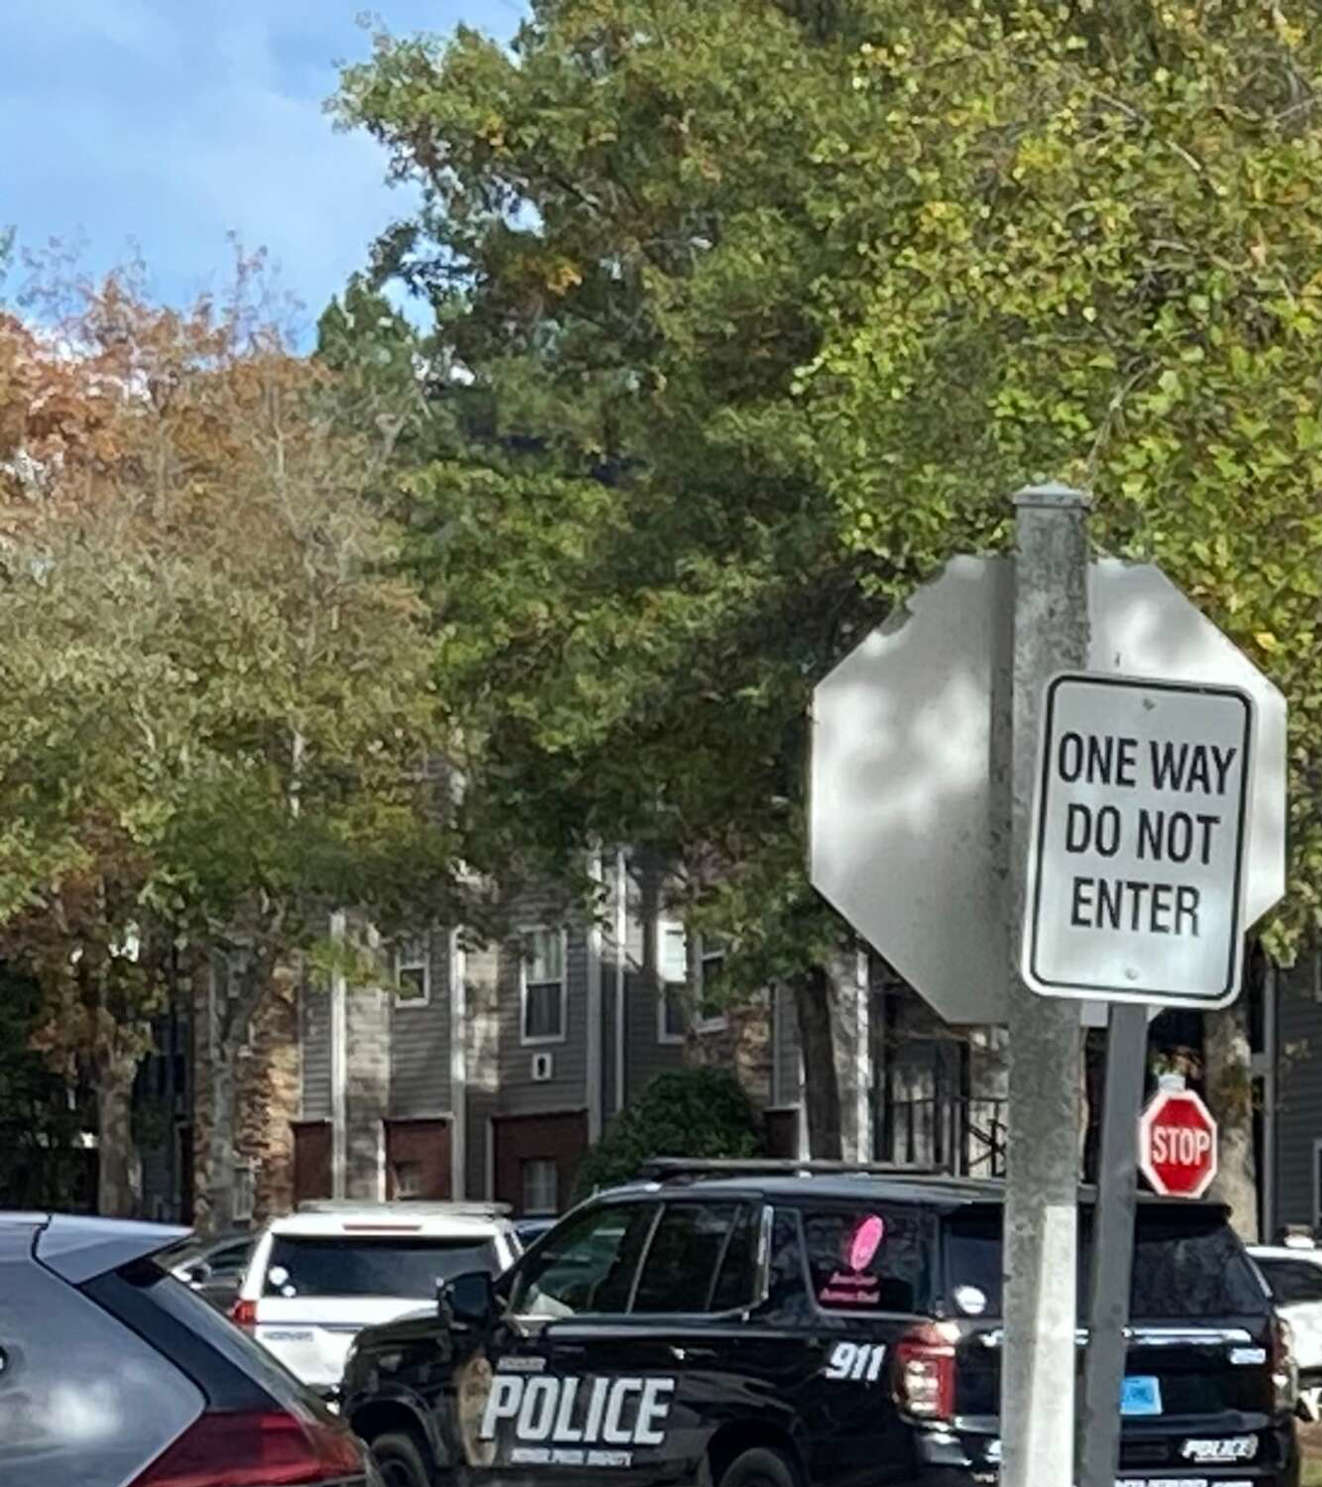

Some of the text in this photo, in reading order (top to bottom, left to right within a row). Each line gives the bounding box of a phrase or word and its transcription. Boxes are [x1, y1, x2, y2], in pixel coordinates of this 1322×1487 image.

[1058, 732, 1238, 795] ONE WAY
[1065, 803, 1222, 866] DO NOT
[1070, 877, 1201, 937] ENTER
[1152, 1126, 1211, 1166] STOP
[824, 1342, 887, 1382] 911
[479, 1375, 675, 1444] POLICE
